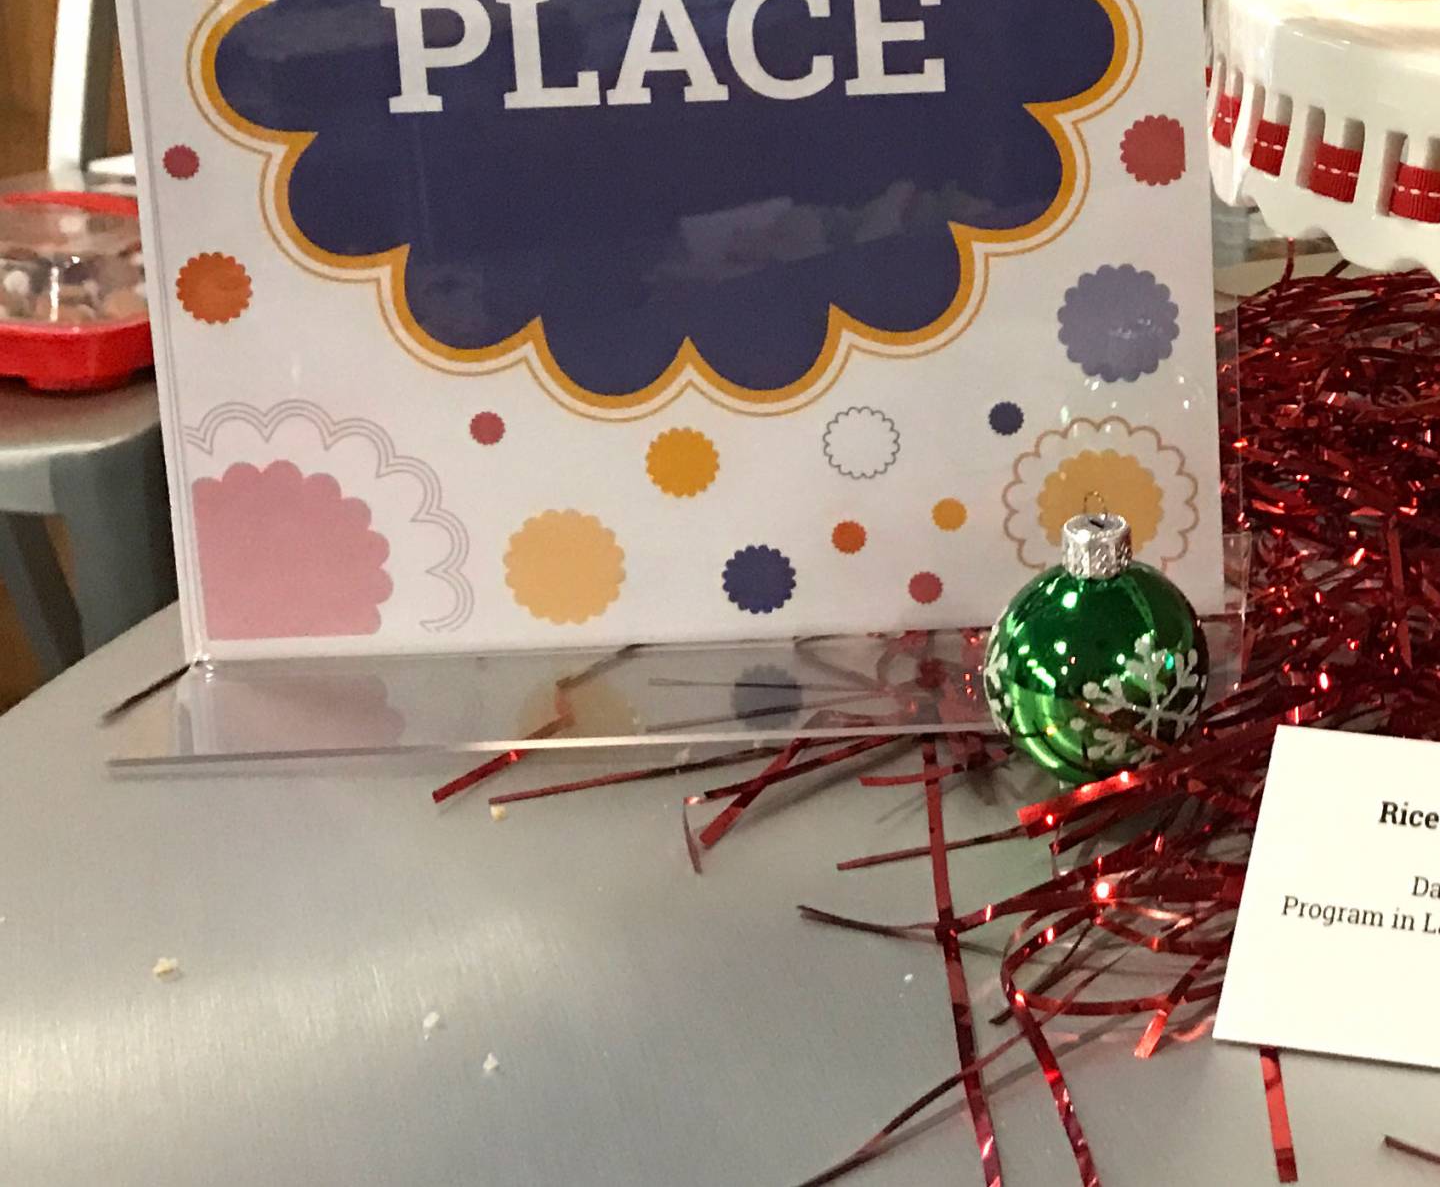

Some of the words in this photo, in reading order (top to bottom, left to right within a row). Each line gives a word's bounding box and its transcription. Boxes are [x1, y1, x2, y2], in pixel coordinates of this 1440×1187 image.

[1379, 801, 1440, 831] Rice
[1281, 895, 1384, 930] Program
[1391, 906, 1416, 932] in
